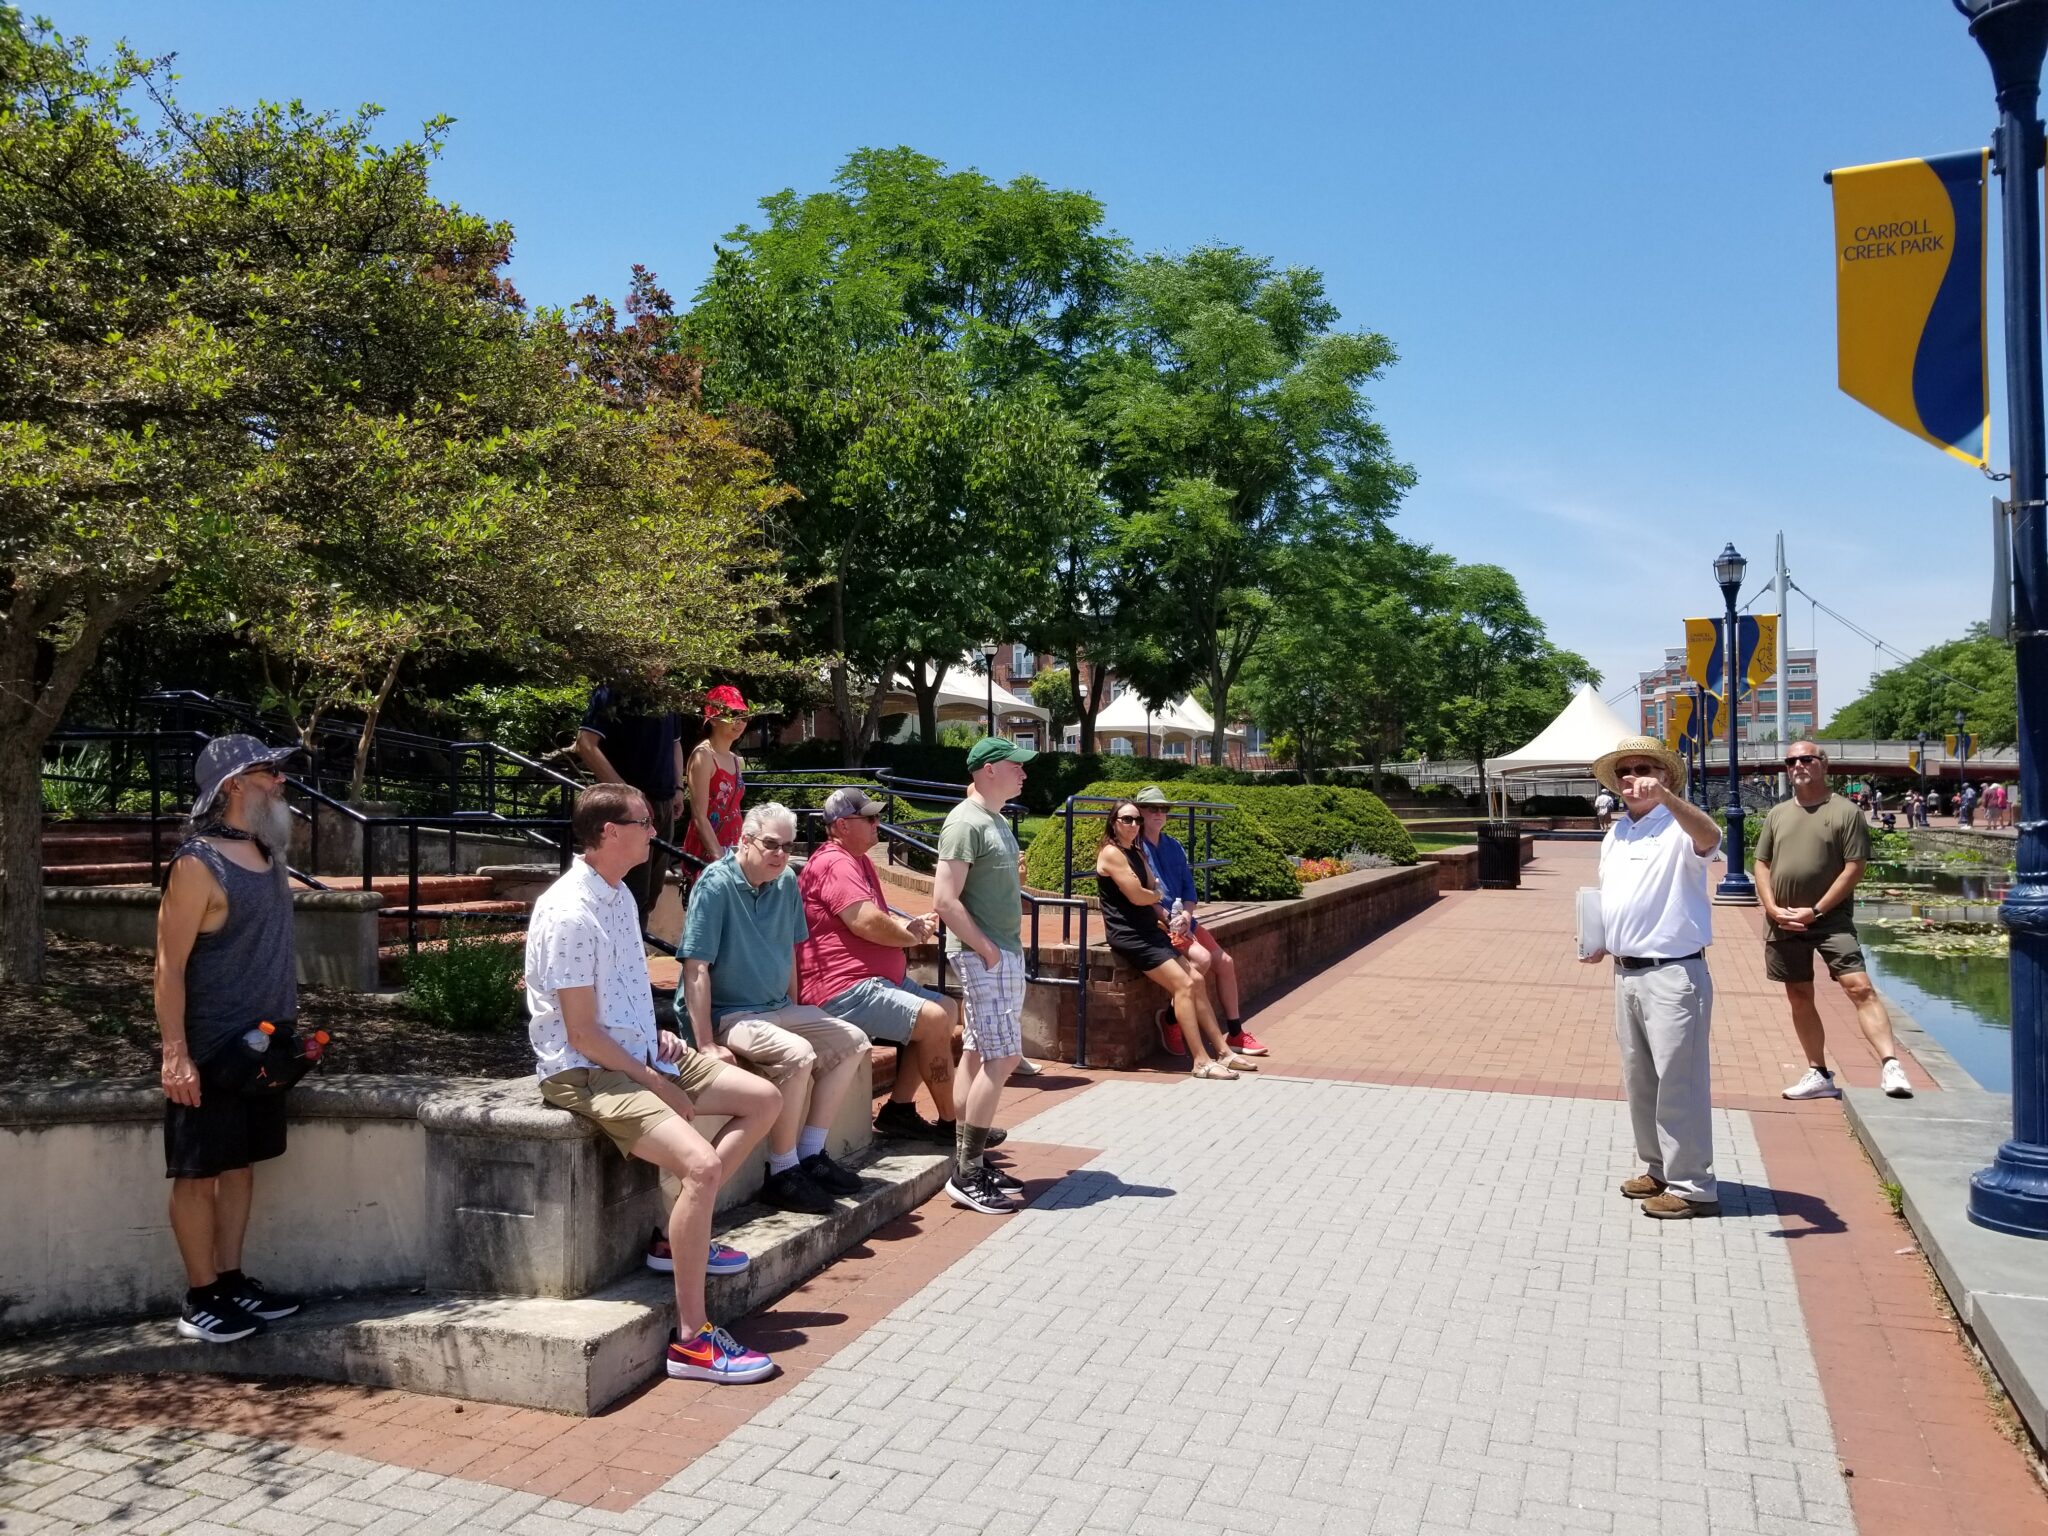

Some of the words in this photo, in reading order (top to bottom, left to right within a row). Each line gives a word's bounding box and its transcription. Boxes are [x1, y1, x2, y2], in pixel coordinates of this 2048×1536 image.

[1854, 218, 1933, 242] CARROLL
[1843, 241, 1897, 262] CREEK
[1901, 234, 1945, 256] PARK
